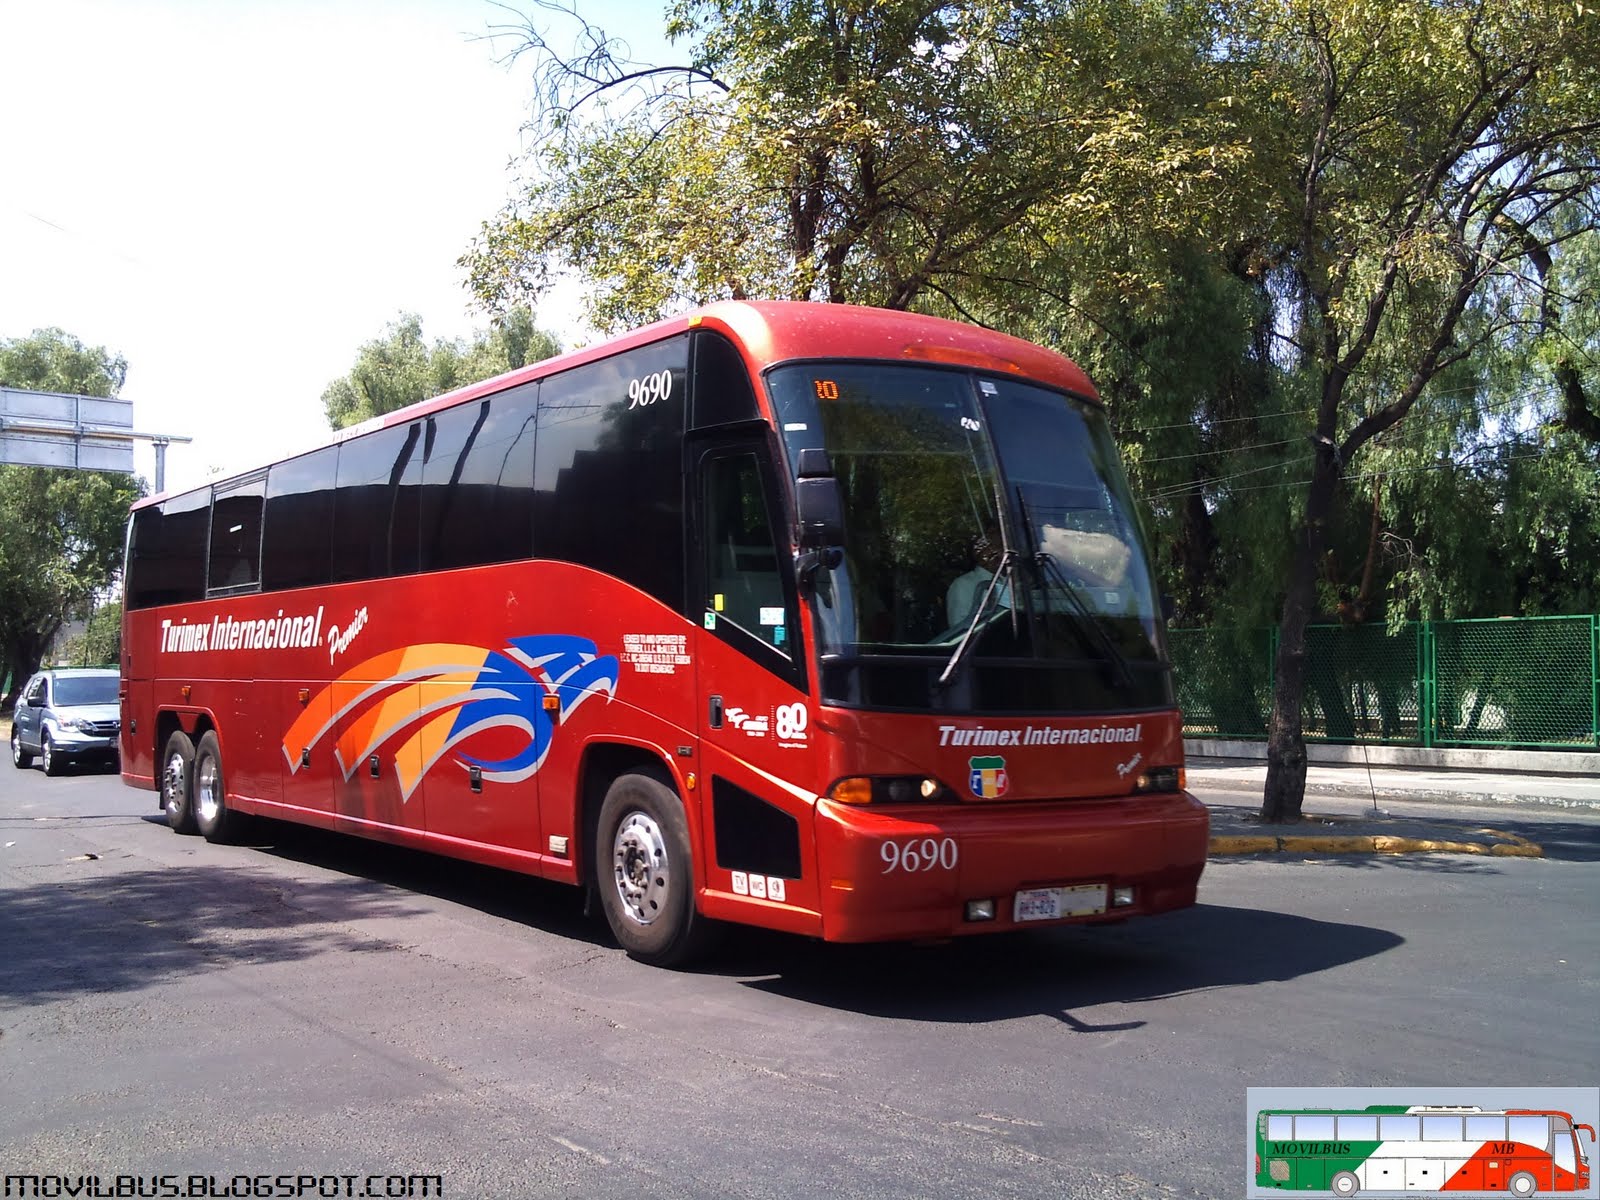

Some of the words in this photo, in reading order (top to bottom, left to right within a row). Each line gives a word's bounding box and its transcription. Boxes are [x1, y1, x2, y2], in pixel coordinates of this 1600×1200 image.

[628, 369, 672, 410] 9690
[161, 618, 209, 653] Turimex
[327, 606, 369, 665] Premier
[776, 702, 807, 739] 80
[938, 725, 1020, 747] Turimex
[1023, 724, 1142, 745] Internacional
[880, 838, 958, 874] 9690
